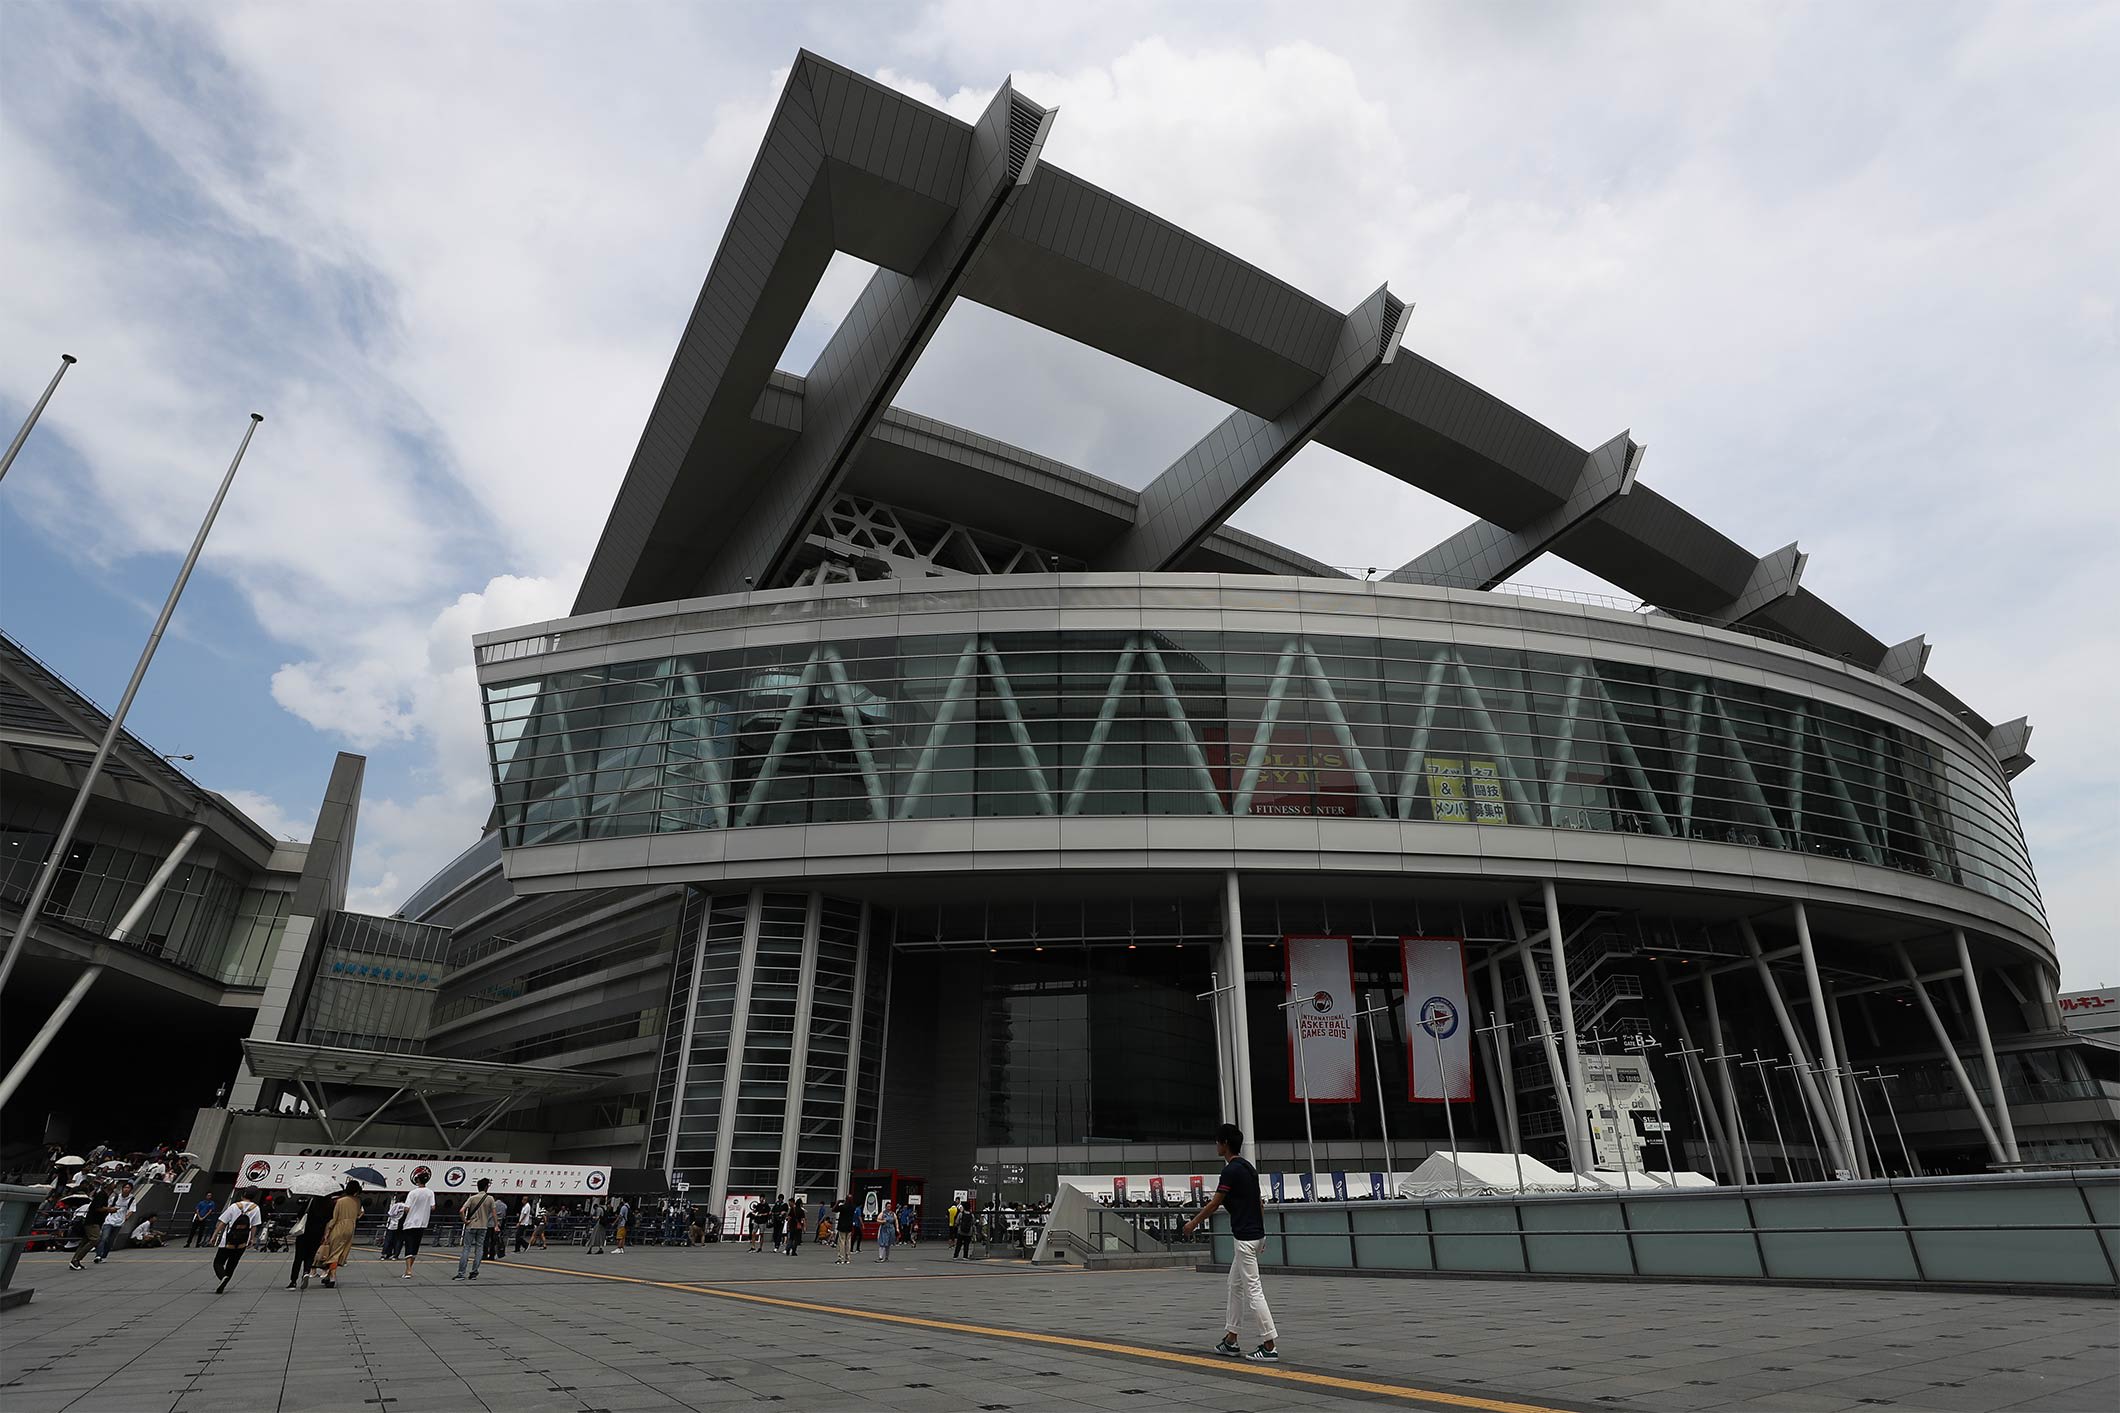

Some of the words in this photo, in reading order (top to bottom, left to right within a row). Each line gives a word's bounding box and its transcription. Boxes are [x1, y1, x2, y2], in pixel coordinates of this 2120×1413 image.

[1427, 765, 1494, 779] フィッネス
[1441, 782, 1452, 796] &
[1256, 804, 1301, 815] FITNESS
[1302, 805, 1347, 815] CNTER
[1302, 1028, 1326, 1039] GAMES
[1328, 1028, 1347, 1040] 2019
[299, 1148, 377, 1159] SAITAMA
